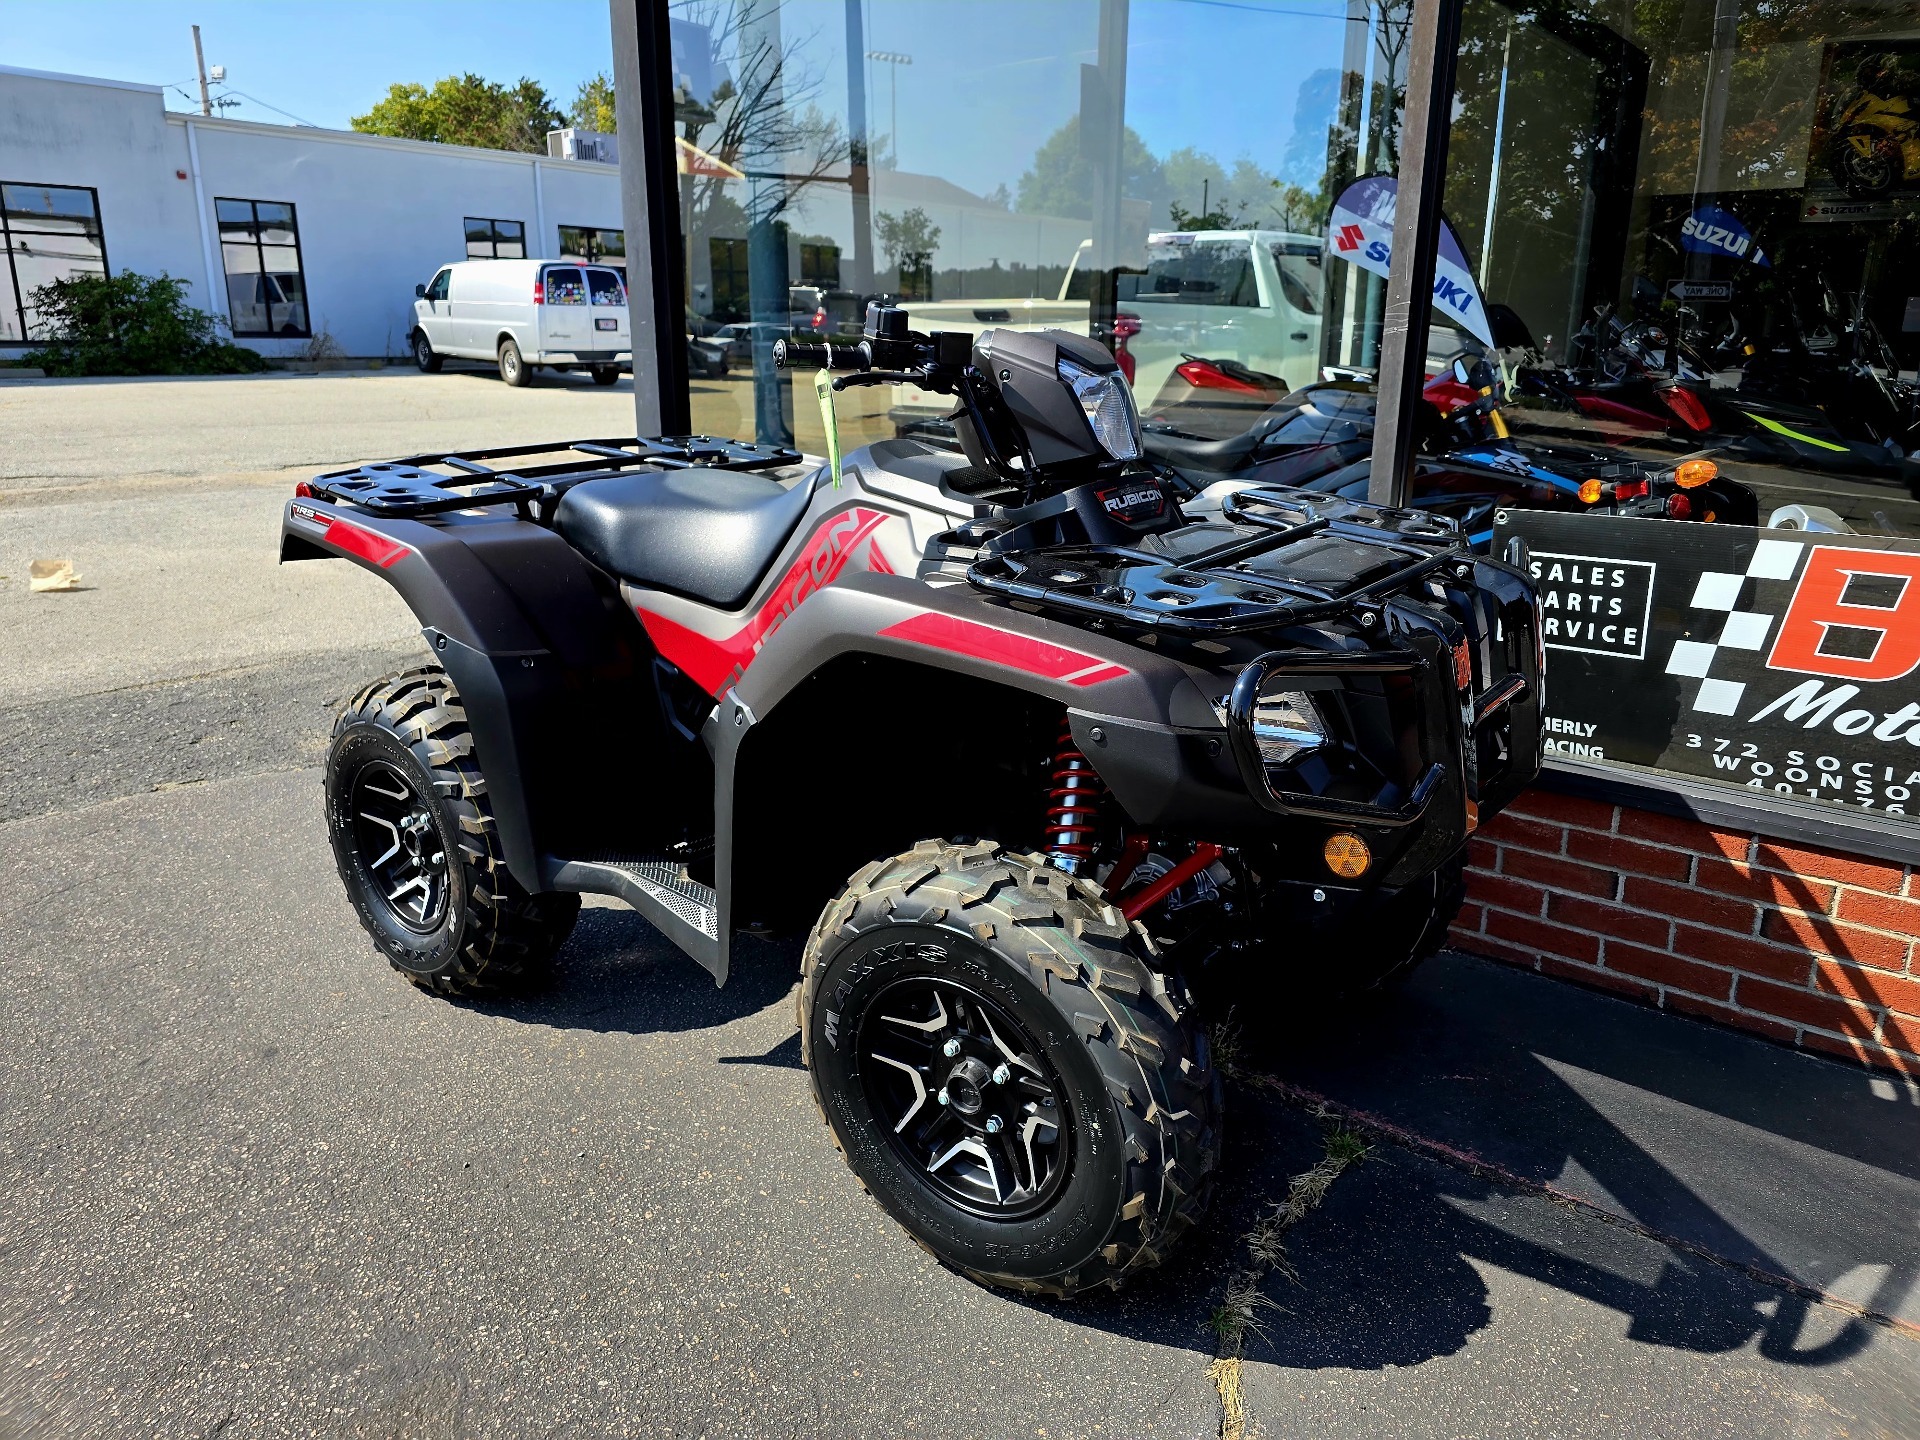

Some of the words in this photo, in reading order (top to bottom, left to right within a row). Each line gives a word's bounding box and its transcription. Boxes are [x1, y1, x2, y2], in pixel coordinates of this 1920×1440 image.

[1821, 206, 1872, 215] SUZUKI
[1103, 489, 1164, 512] RUBICON
[1530, 562, 1625, 588] SALES
[1544, 591, 1622, 616] ARTS
[1545, 618, 1637, 645] RVICE
[1544, 717, 1598, 737] ERLY
[1544, 738, 1604, 760] ACING
[1685, 733, 1759, 759] 372
[1712, 753, 1910, 801] WOONSO
[1746, 777, 1920, 817] 401-76
[824, 941, 948, 1049] MAXXIS
